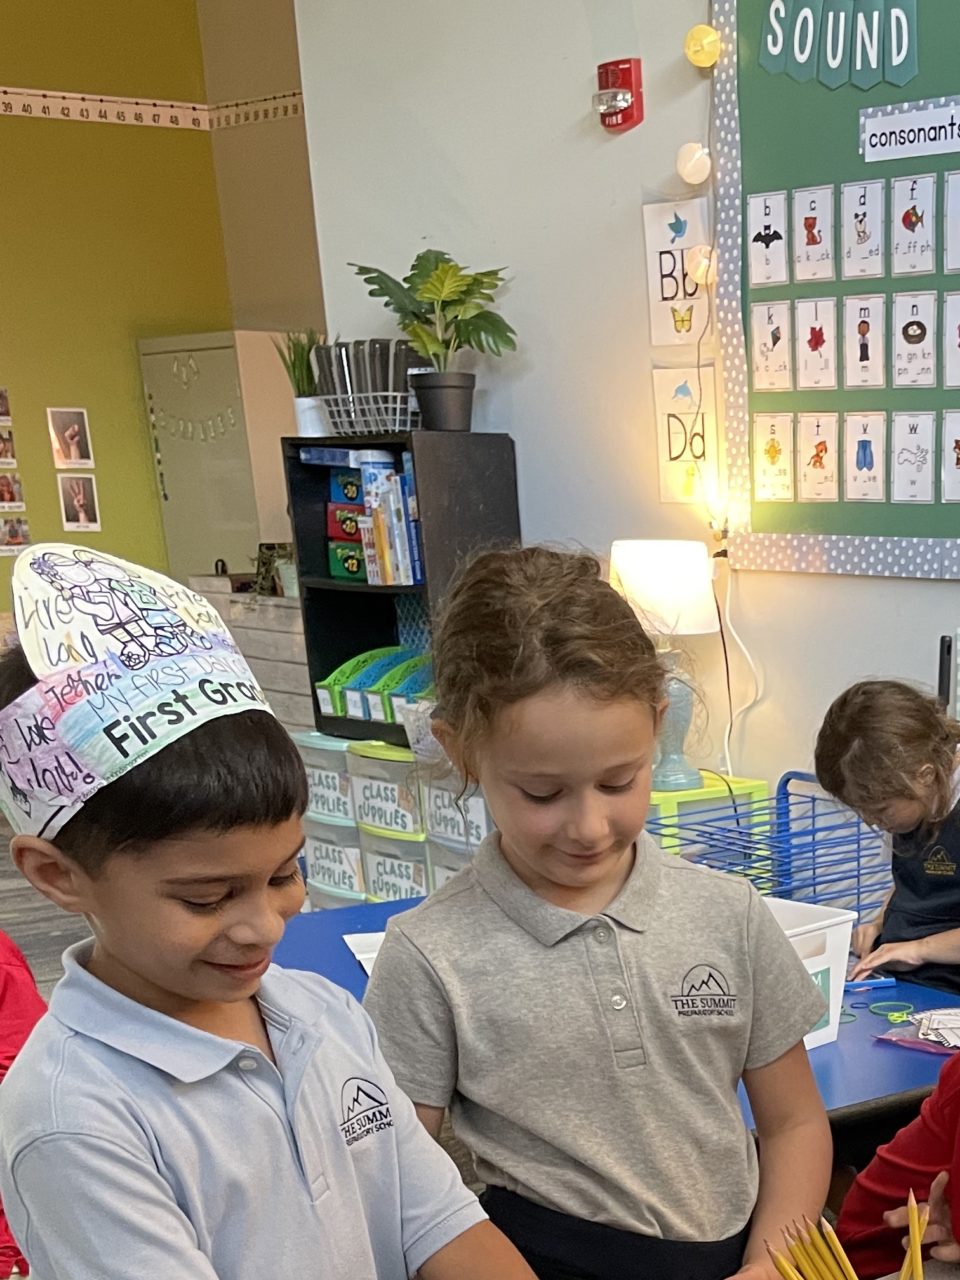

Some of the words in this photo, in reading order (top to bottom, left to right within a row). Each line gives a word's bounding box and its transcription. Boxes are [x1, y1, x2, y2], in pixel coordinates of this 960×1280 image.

[766, 0, 909, 71] SOUND
[764, 198, 771, 217] b
[809, 200, 816, 211] c
[859, 307, 870, 318] m
[911, 304, 918, 316] n
[667, 412, 706, 462] Dd
[103, 689, 198, 759] First
[198, 678, 265, 705] Gra
[311, 792, 348, 816] PPLIES
[362, 783, 397, 804] CLASS
[358, 802, 407, 830] SUPPLIES
[430, 810, 481, 841] SUPPLES
[313, 846, 343, 865] CLASS
[310, 862, 354, 890] SUPPLIES
[376, 859, 411, 880] CLASS
[671, 998, 699, 1010] THE
[700, 997, 737, 1009] SUMMIT
[341, 1121, 357, 1139] THE
